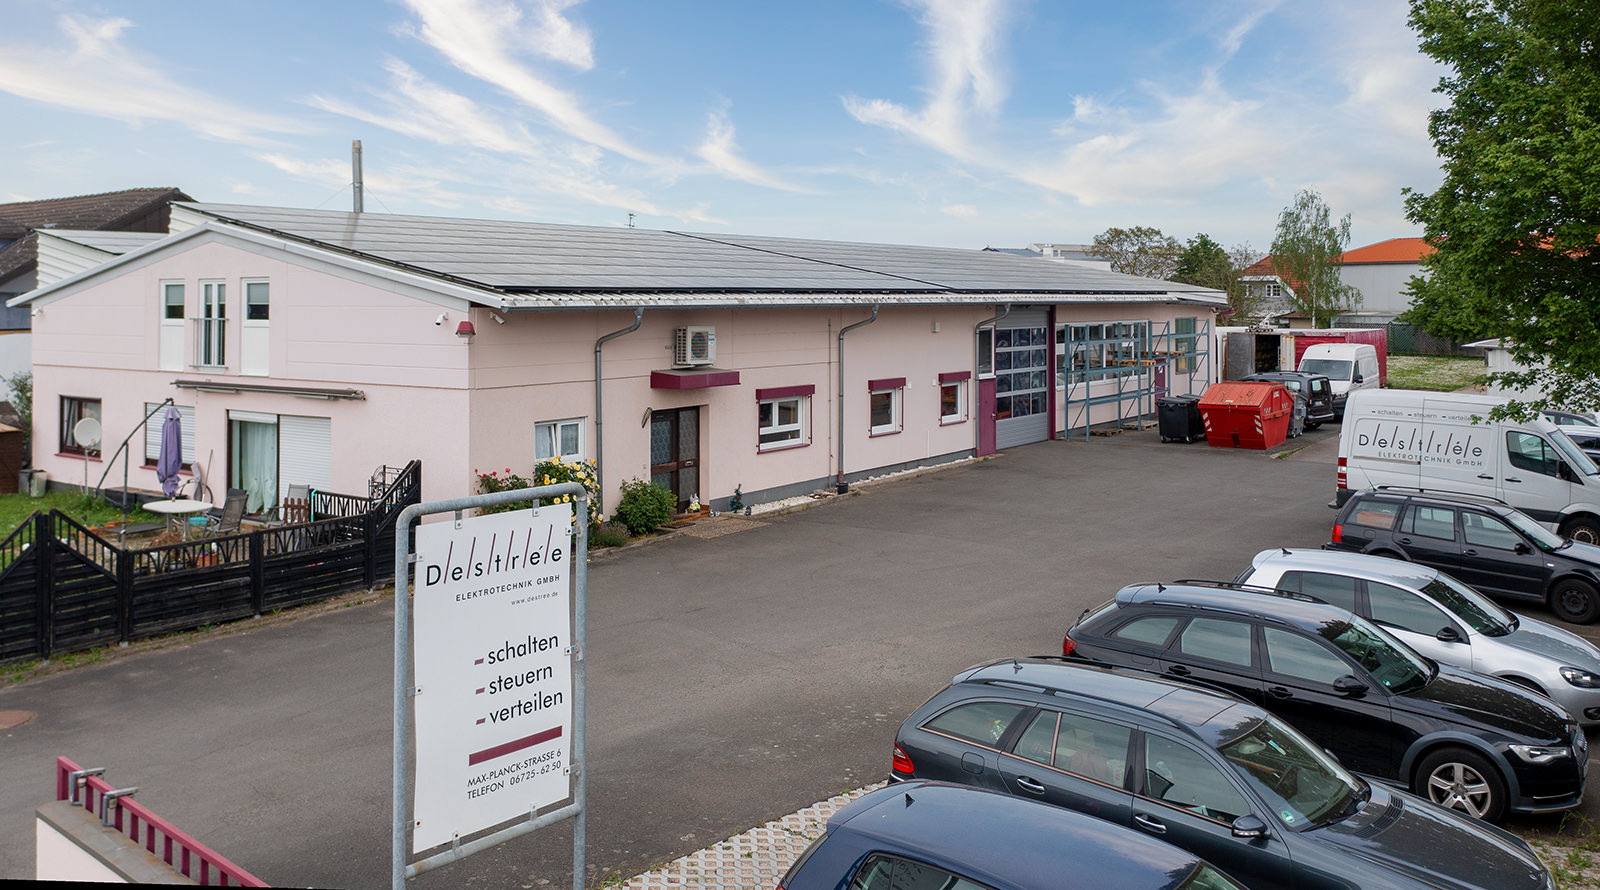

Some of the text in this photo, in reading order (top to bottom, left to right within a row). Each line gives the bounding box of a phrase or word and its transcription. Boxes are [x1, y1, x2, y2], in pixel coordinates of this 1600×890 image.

[1377, 409, 1403, 417] schalten
[1378, 451, 1482, 467] ELEKTROTECHNIK GmbH
[455, 574, 560, 602] ELEKTROTECHNIK GMBH
[511, 591, 559, 605] www.destree.de
[488, 635, 559, 665] schalten
[489, 665, 553, 695] steuern
[489, 691, 563, 723] verteilen
[467, 748, 562, 788] MAX-PLANCK-STRASSE 6
[467, 780, 505, 800] TELEFON
